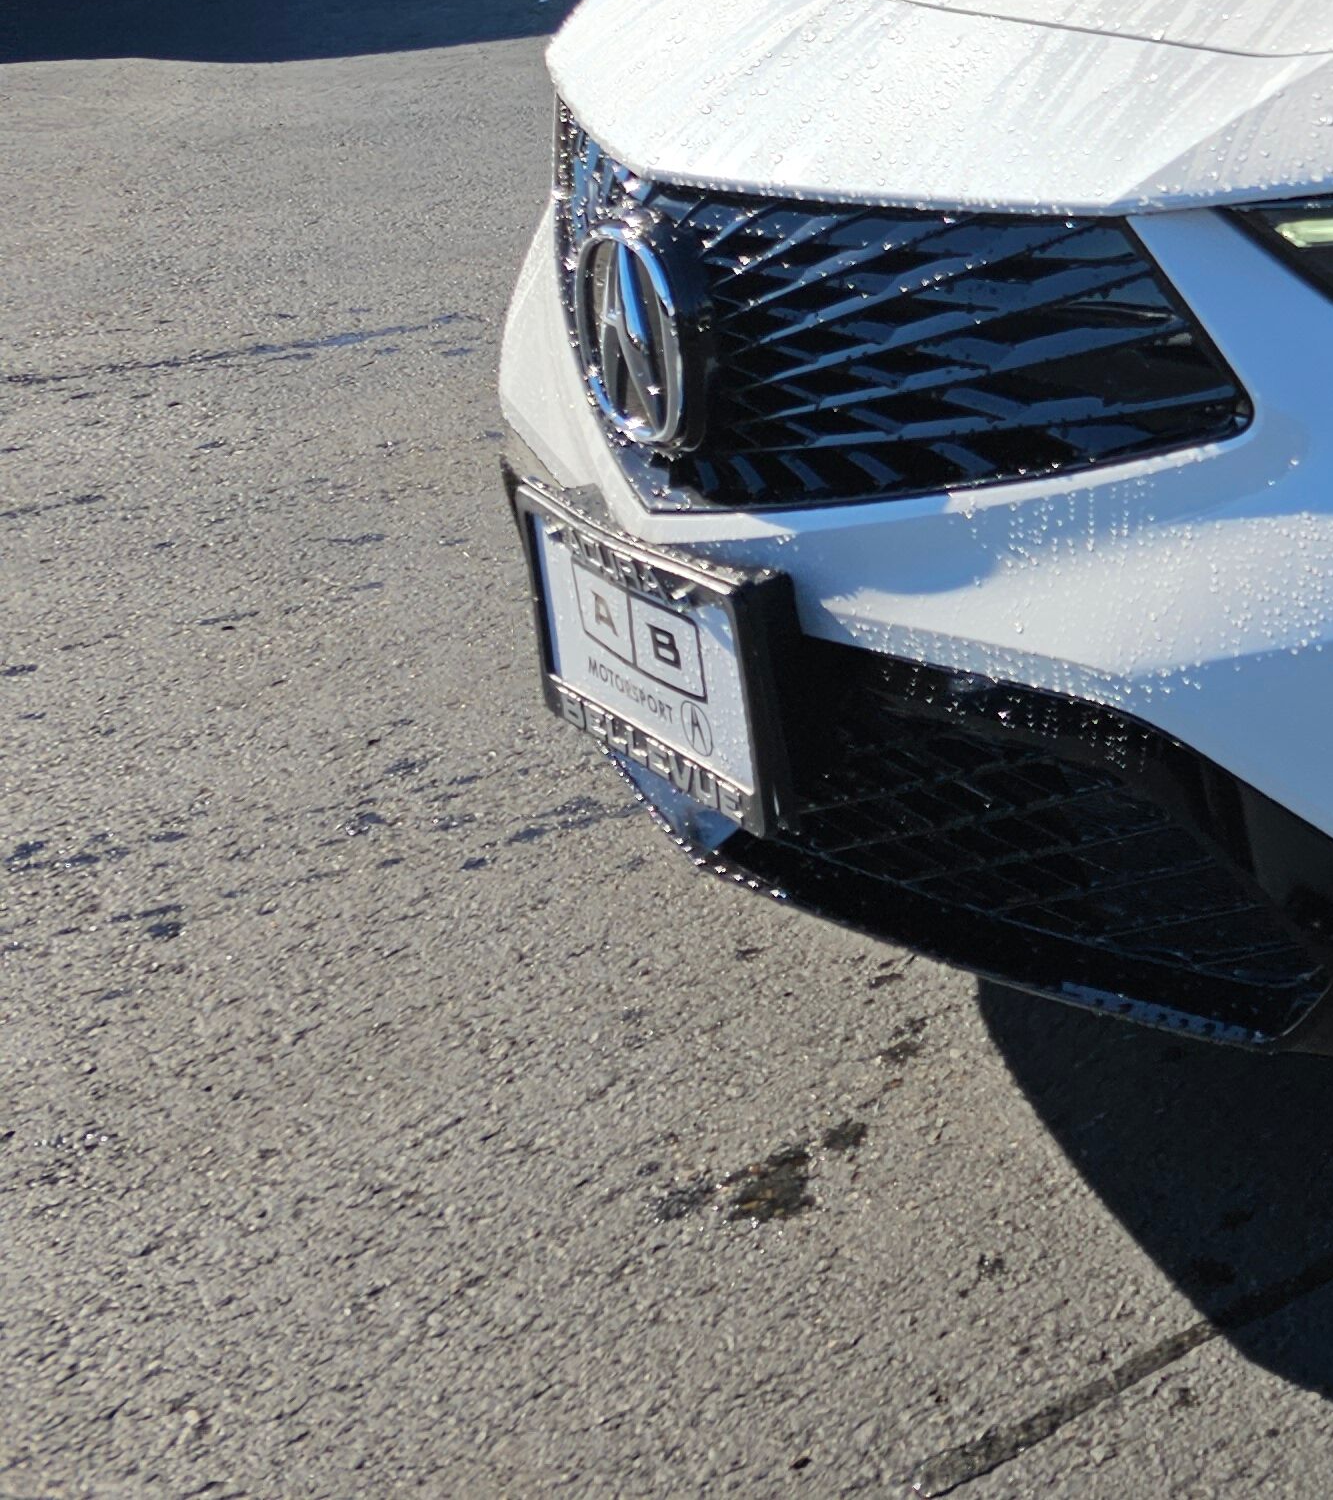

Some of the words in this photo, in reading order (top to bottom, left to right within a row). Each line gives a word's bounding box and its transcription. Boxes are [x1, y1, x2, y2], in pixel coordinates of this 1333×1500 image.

[564, 526, 669, 603] ACURA
[591, 591, 619, 638] A
[647, 623, 682, 670] B
[588, 656, 674, 725] MOTORSPORT
[559, 687, 745, 827] BELLEVUE
